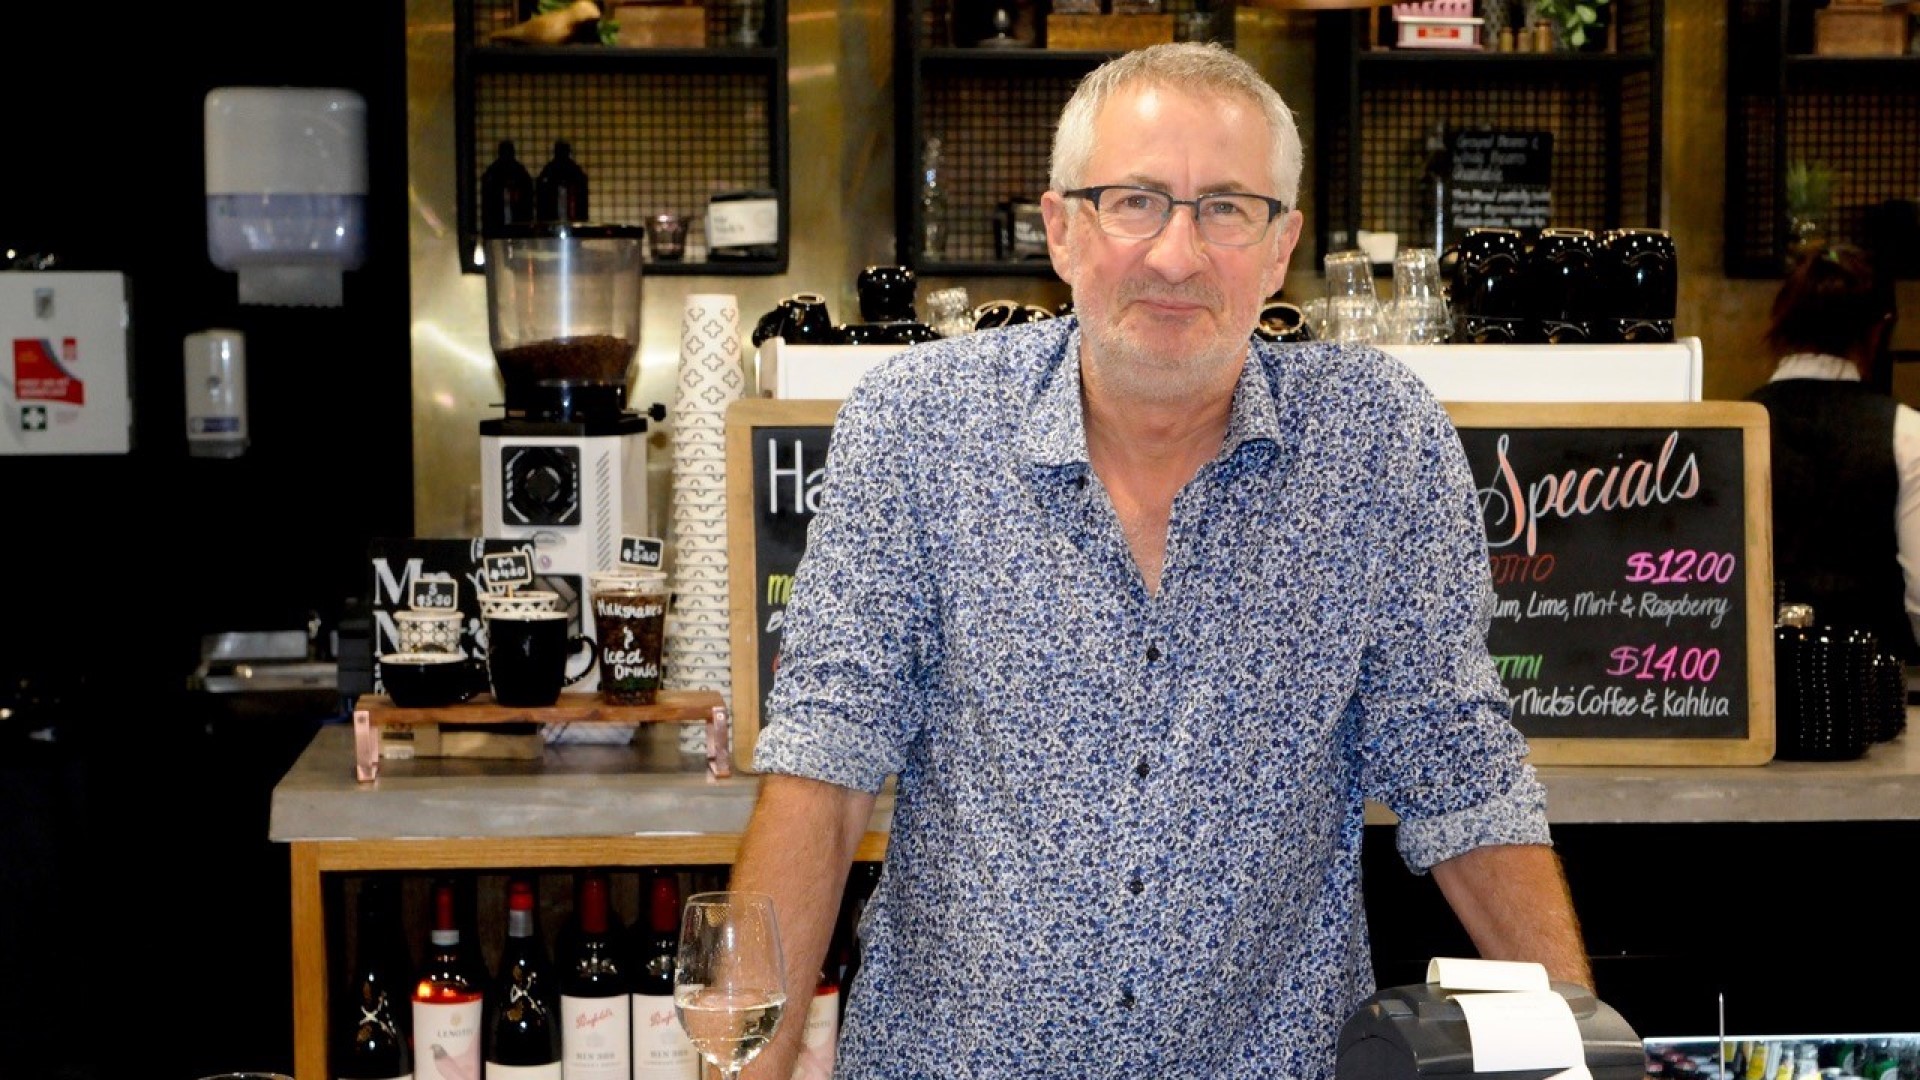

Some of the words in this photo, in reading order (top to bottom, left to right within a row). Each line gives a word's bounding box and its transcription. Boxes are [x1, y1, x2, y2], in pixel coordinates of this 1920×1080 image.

[1476, 430, 1699, 555] Specials
[1625, 548, 1736, 584] $12.00
[1526, 590, 1570, 622] Lime,
[1573, 590, 1617, 617] Mint
[1620, 594, 1636, 618] &
[1638, 592, 1732, 630] Raspberry
[1491, 654, 1543, 680] TINI
[1606, 643, 1720, 682] $14.00
[1577, 685, 1638, 717] Coffee
[1641, 689, 1658, 717] &
[1663, 686, 1729, 717] Kahlua
